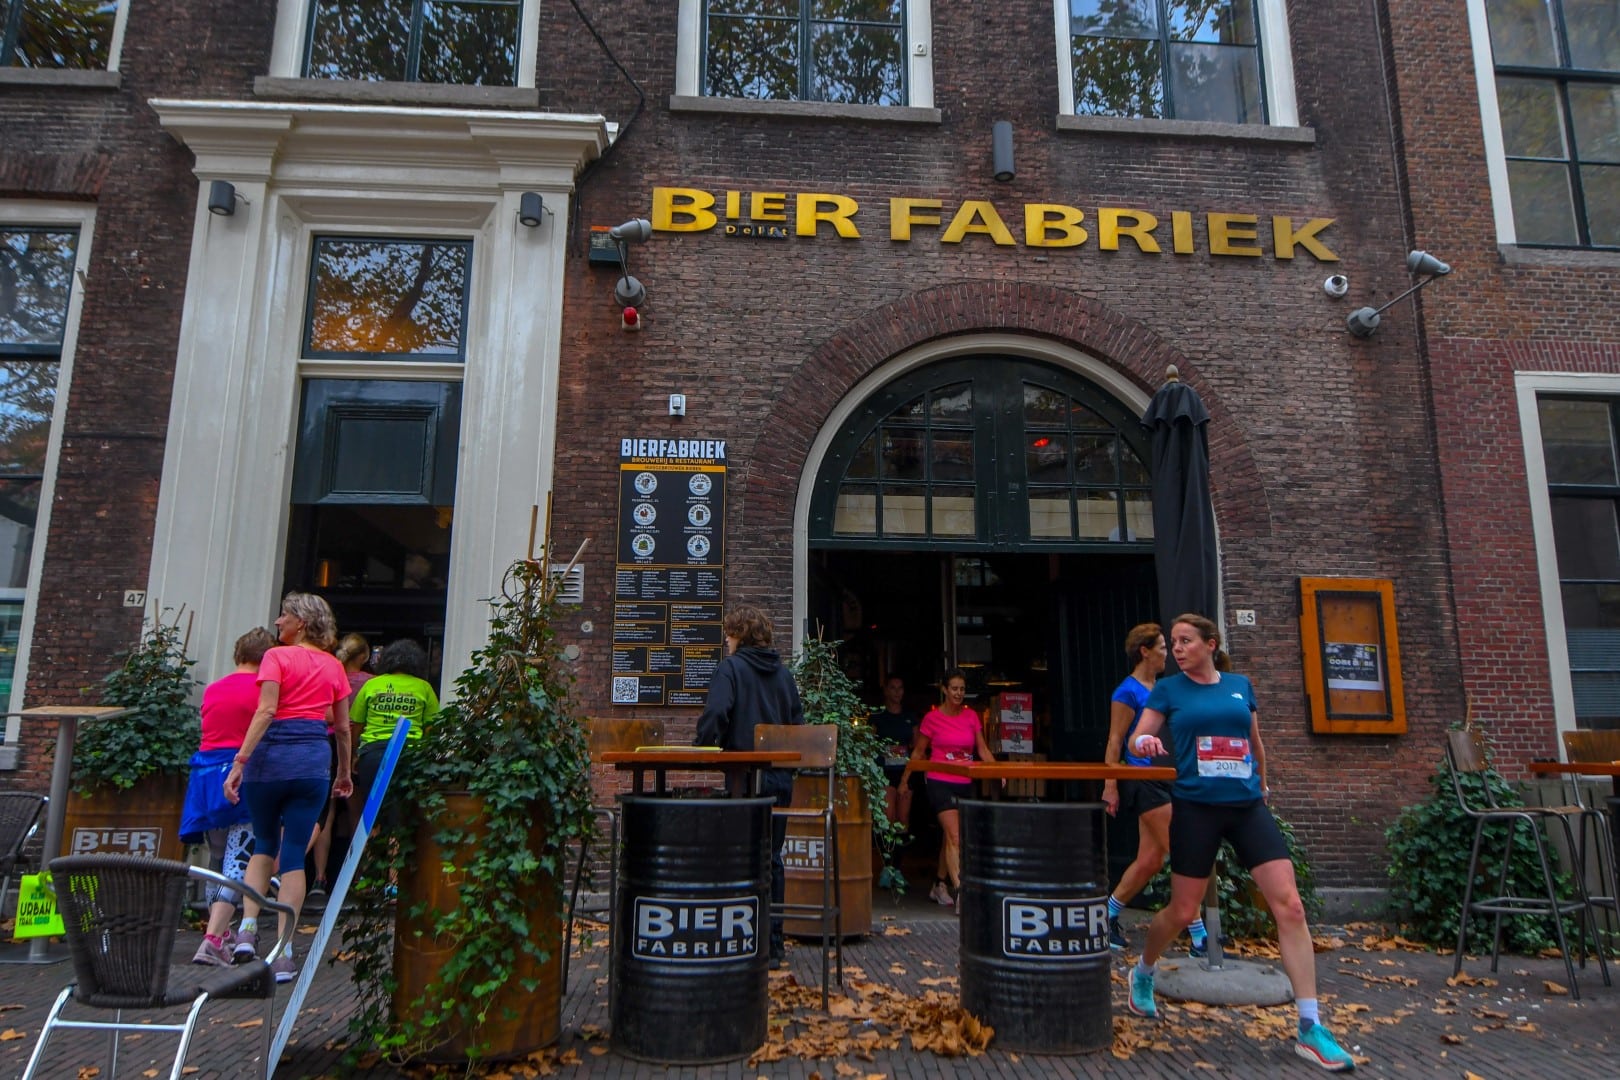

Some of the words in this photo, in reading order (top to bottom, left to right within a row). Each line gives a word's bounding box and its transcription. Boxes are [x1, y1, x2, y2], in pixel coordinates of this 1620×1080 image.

[652, 187, 861, 238] BIER
[889, 197, 1341, 262] FABRIEK
[725, 225, 789, 236] Delft
[621, 439, 726, 459] BIERFABRIEK
[127, 593, 145, 605] 47
[378, 695, 417, 705] Golden
[373, 703, 416, 715] Tenloop
[1216, 761, 1239, 770] 2017
[74, 831, 158, 851] BIER
[20, 902, 52, 917] URBAN
[638, 904, 755, 939] BIER
[1009, 904, 1109, 937] BIER
[638, 938, 755, 955] FABRIEK
[1010, 936, 1109, 953] FABRIEK
